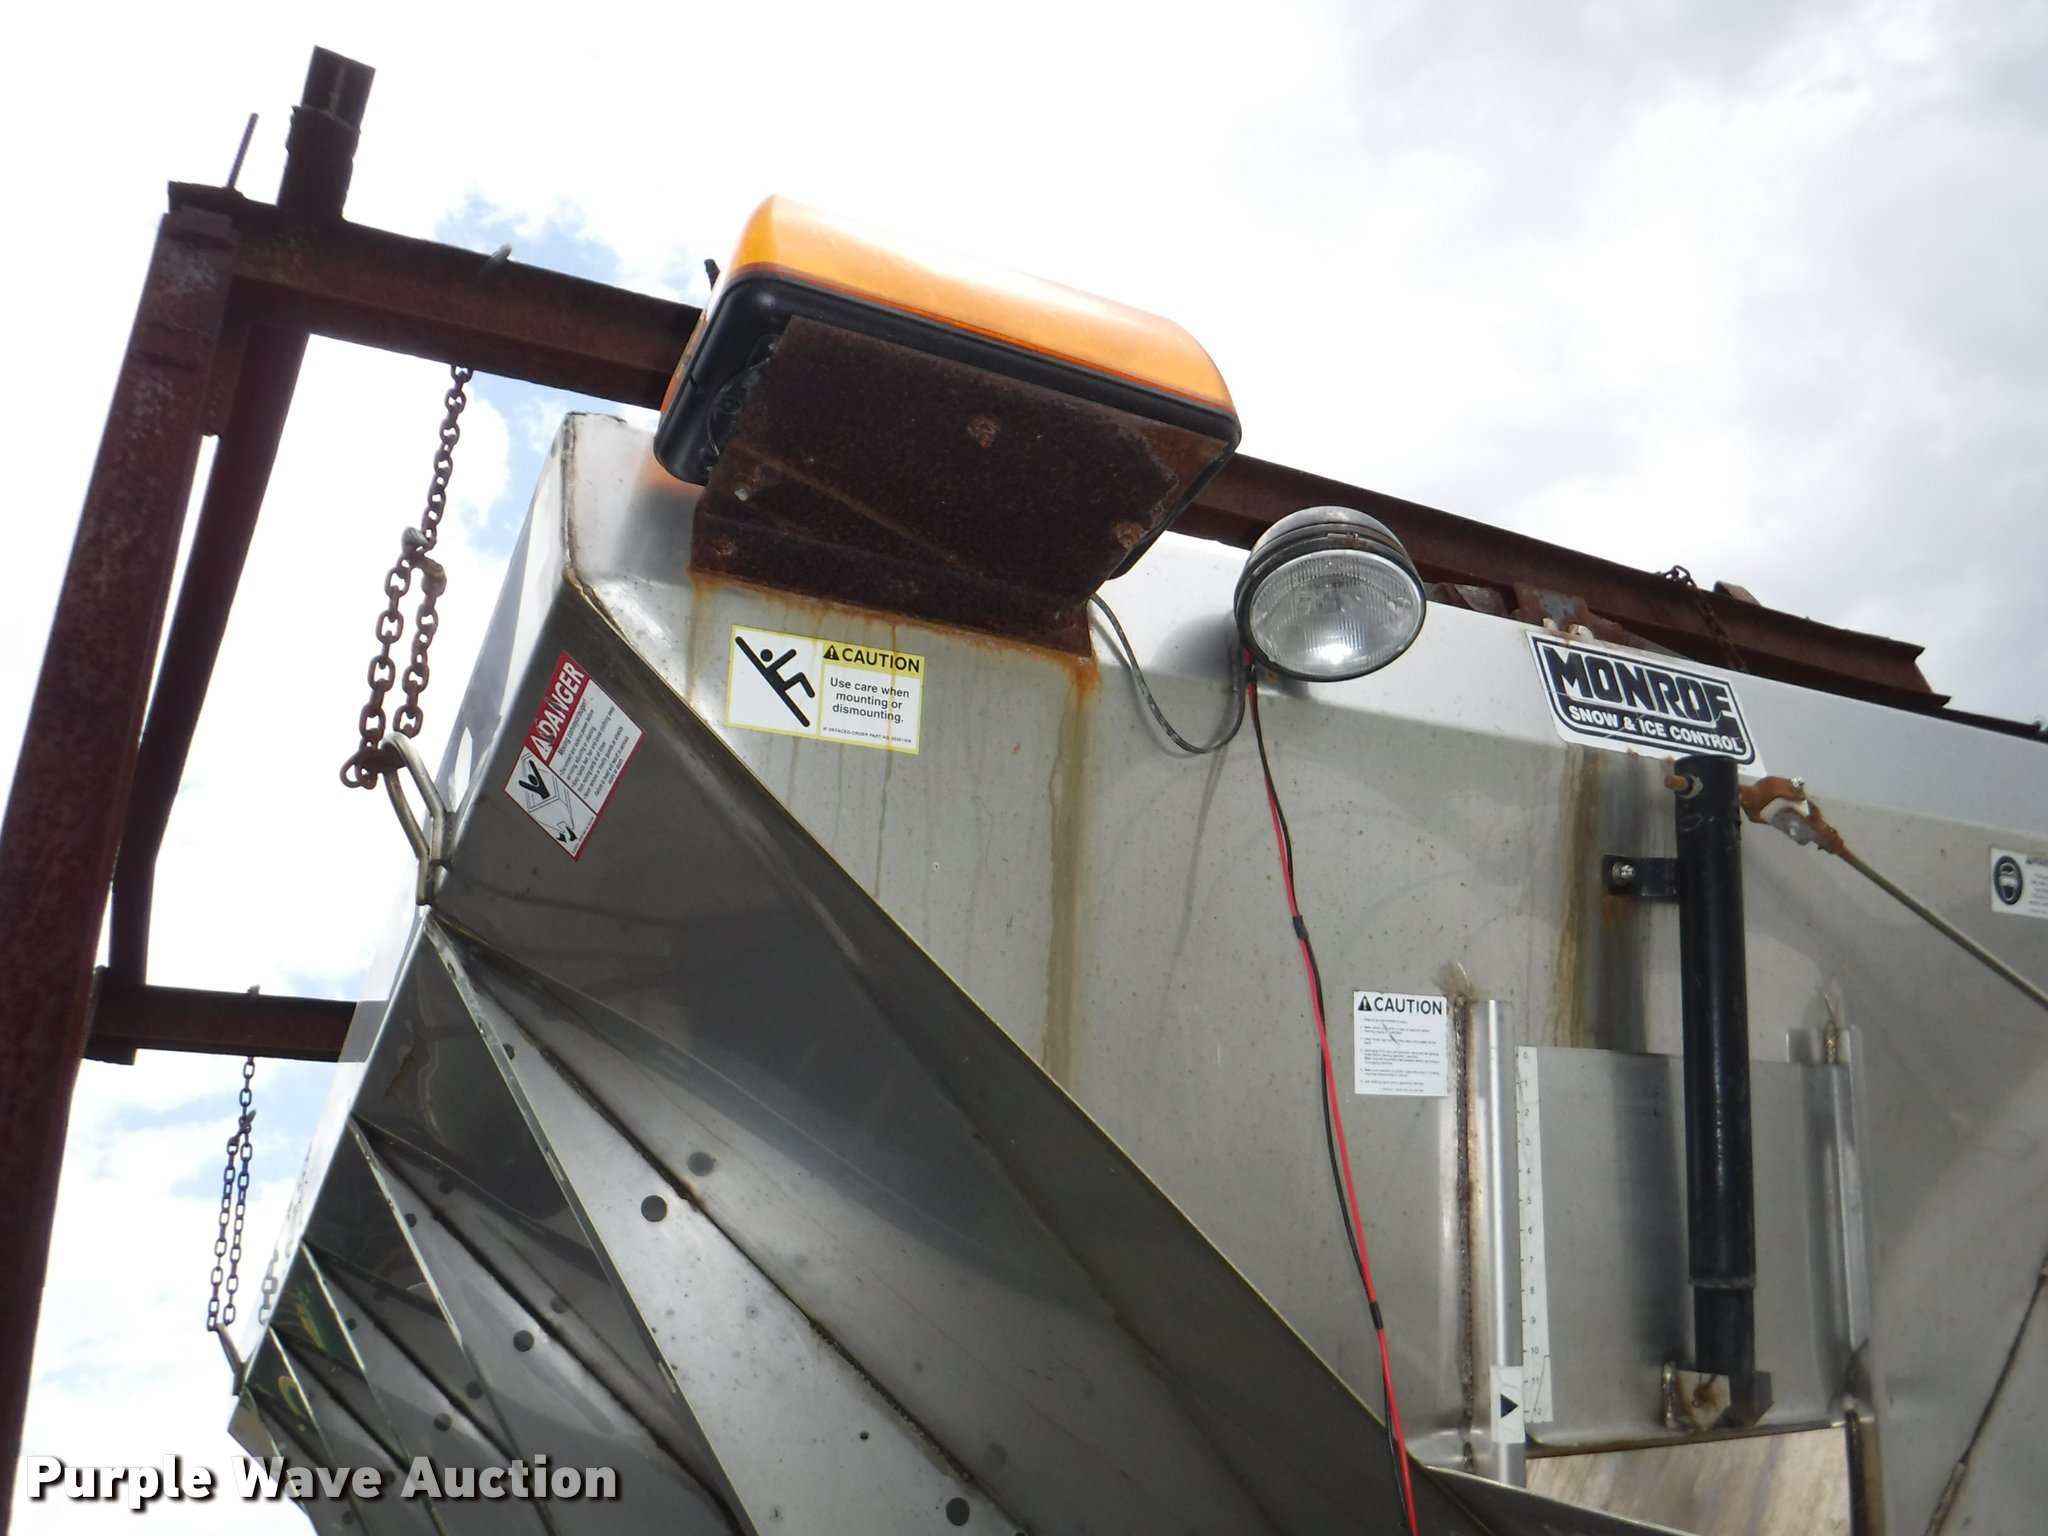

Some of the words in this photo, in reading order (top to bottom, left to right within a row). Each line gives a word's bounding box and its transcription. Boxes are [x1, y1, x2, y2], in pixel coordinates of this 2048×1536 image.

[842, 648, 920, 673] CAUTION
[830, 677, 852, 689] Use
[854, 683, 878, 693] care
[881, 687, 910, 698] when
[1543, 647, 1734, 726] MONROE
[538, 661, 585, 739] DANGER
[836, 692, 888, 709] mounting
[891, 701, 903, 709] or
[832, 703, 904, 724] dismounting.
[1568, 705, 1618, 728] SNOW
[1623, 716, 1637, 732] &
[1639, 720, 1668, 738] ICE
[1669, 725, 1743, 753] CONTROL
[1374, 997, 1442, 1015] CAUTION
[1523, 1051, 1528, 1060] 0
[1524, 1108, 1530, 1117] 2
[1525, 1137, 1530, 1146] 3
[1527, 1195, 1532, 1205] 5
[1528, 1225, 1533, 1235] 6
[1529, 1255, 1534, 1264] 7
[1529, 1285, 1535, 1295] 8
[1531, 1316, 1536, 1325] 9
[1530, 1347, 1540, 1355] 10
[1532, 1377, 1540, 1385] 11
[1533, 1407, 1542, 1416] 12
